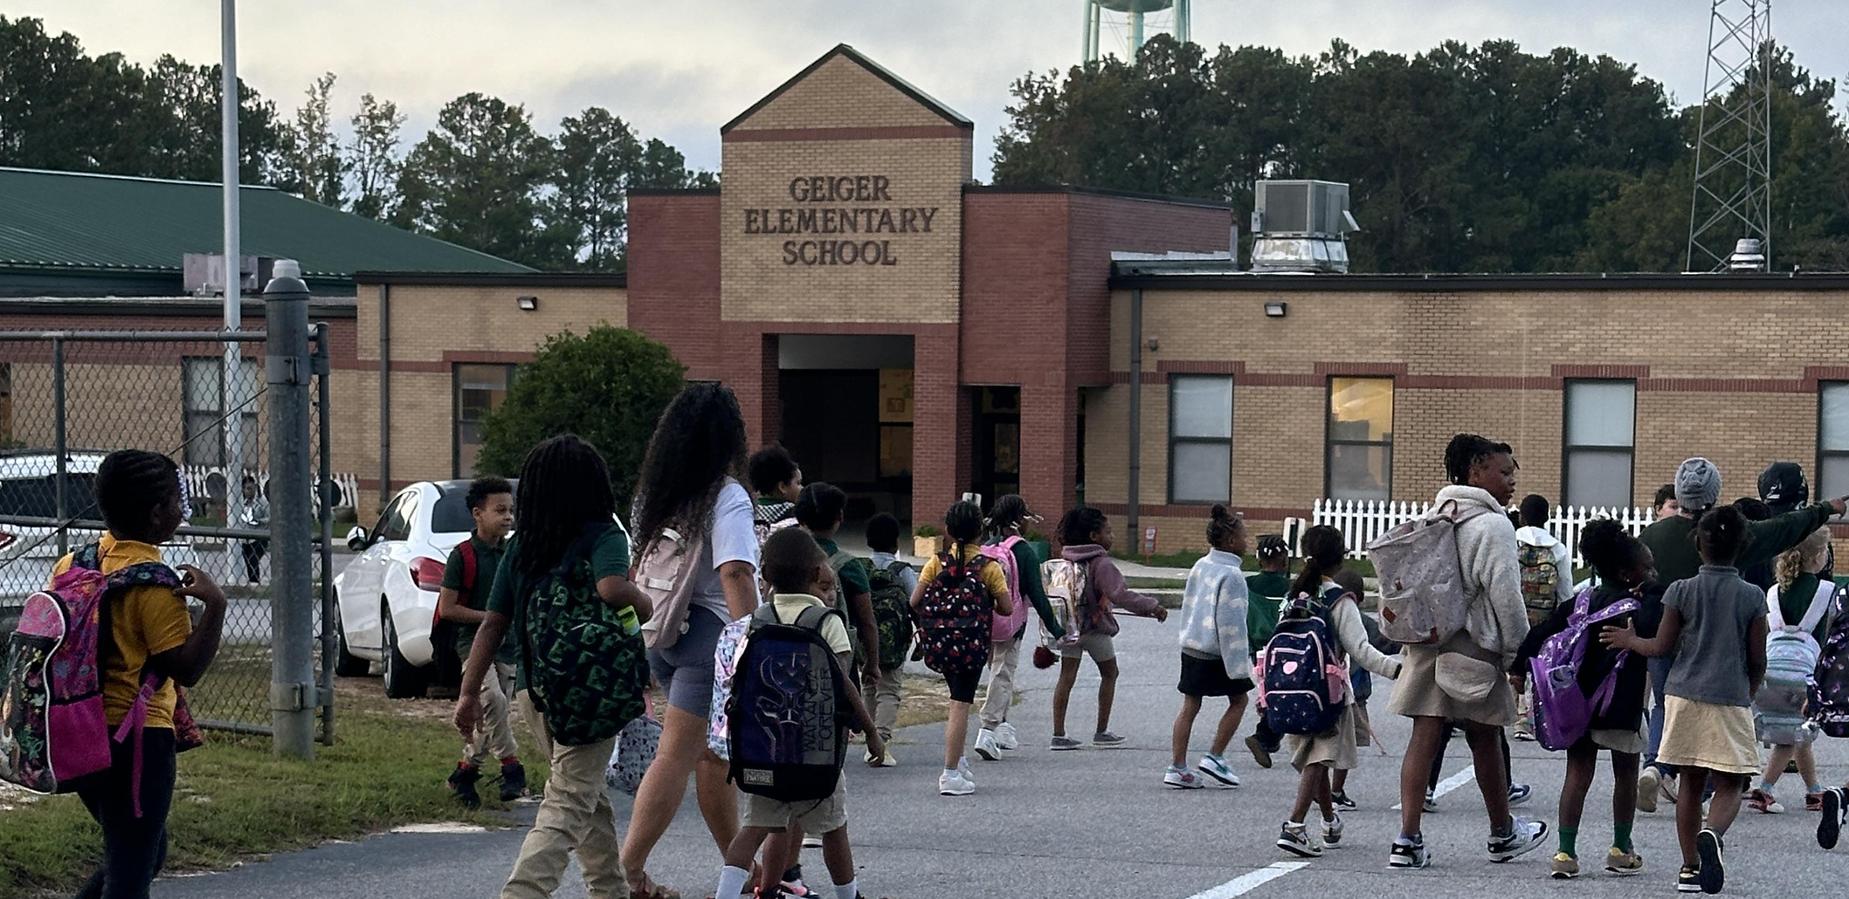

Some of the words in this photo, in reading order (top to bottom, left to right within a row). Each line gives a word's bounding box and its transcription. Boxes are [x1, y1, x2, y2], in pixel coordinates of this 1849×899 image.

[789, 175, 892, 202] GEIGER
[744, 207, 939, 234] ELEMENTARY
[782, 240, 897, 266] SCHOOL
[820, 668, 833, 751] FOREVER
